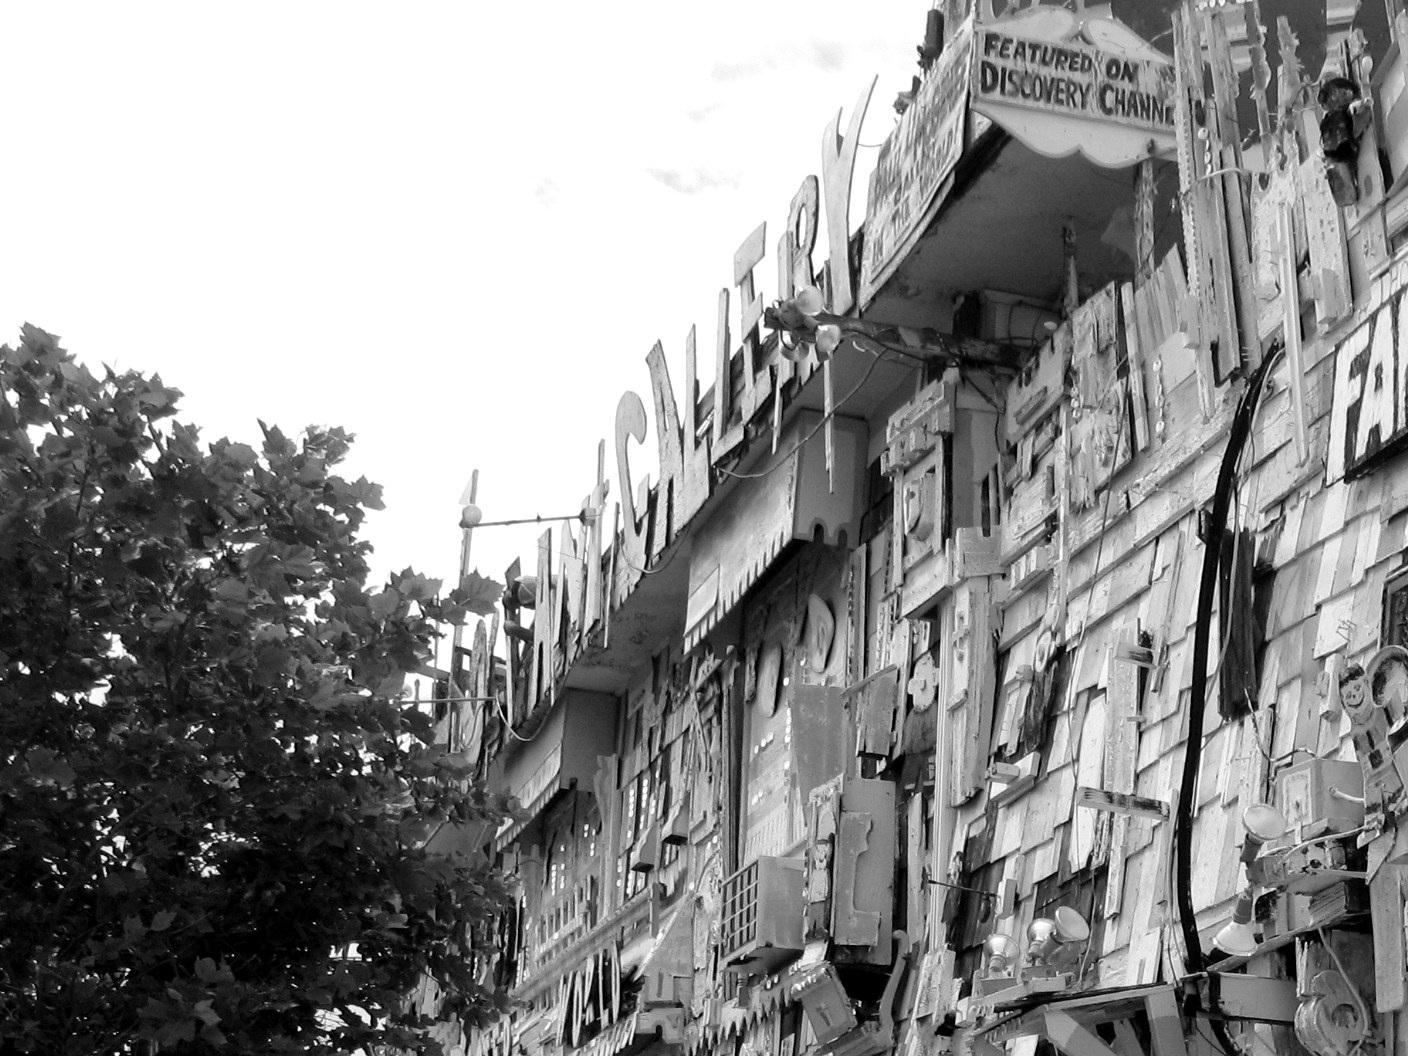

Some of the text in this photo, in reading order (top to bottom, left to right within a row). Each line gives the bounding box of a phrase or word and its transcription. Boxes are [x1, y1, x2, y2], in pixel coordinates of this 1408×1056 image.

[984, 33, 1093, 73] FEATURED
[1106, 58, 1138, 83] ON
[980, 60, 1091, 110] DISCOVERY
